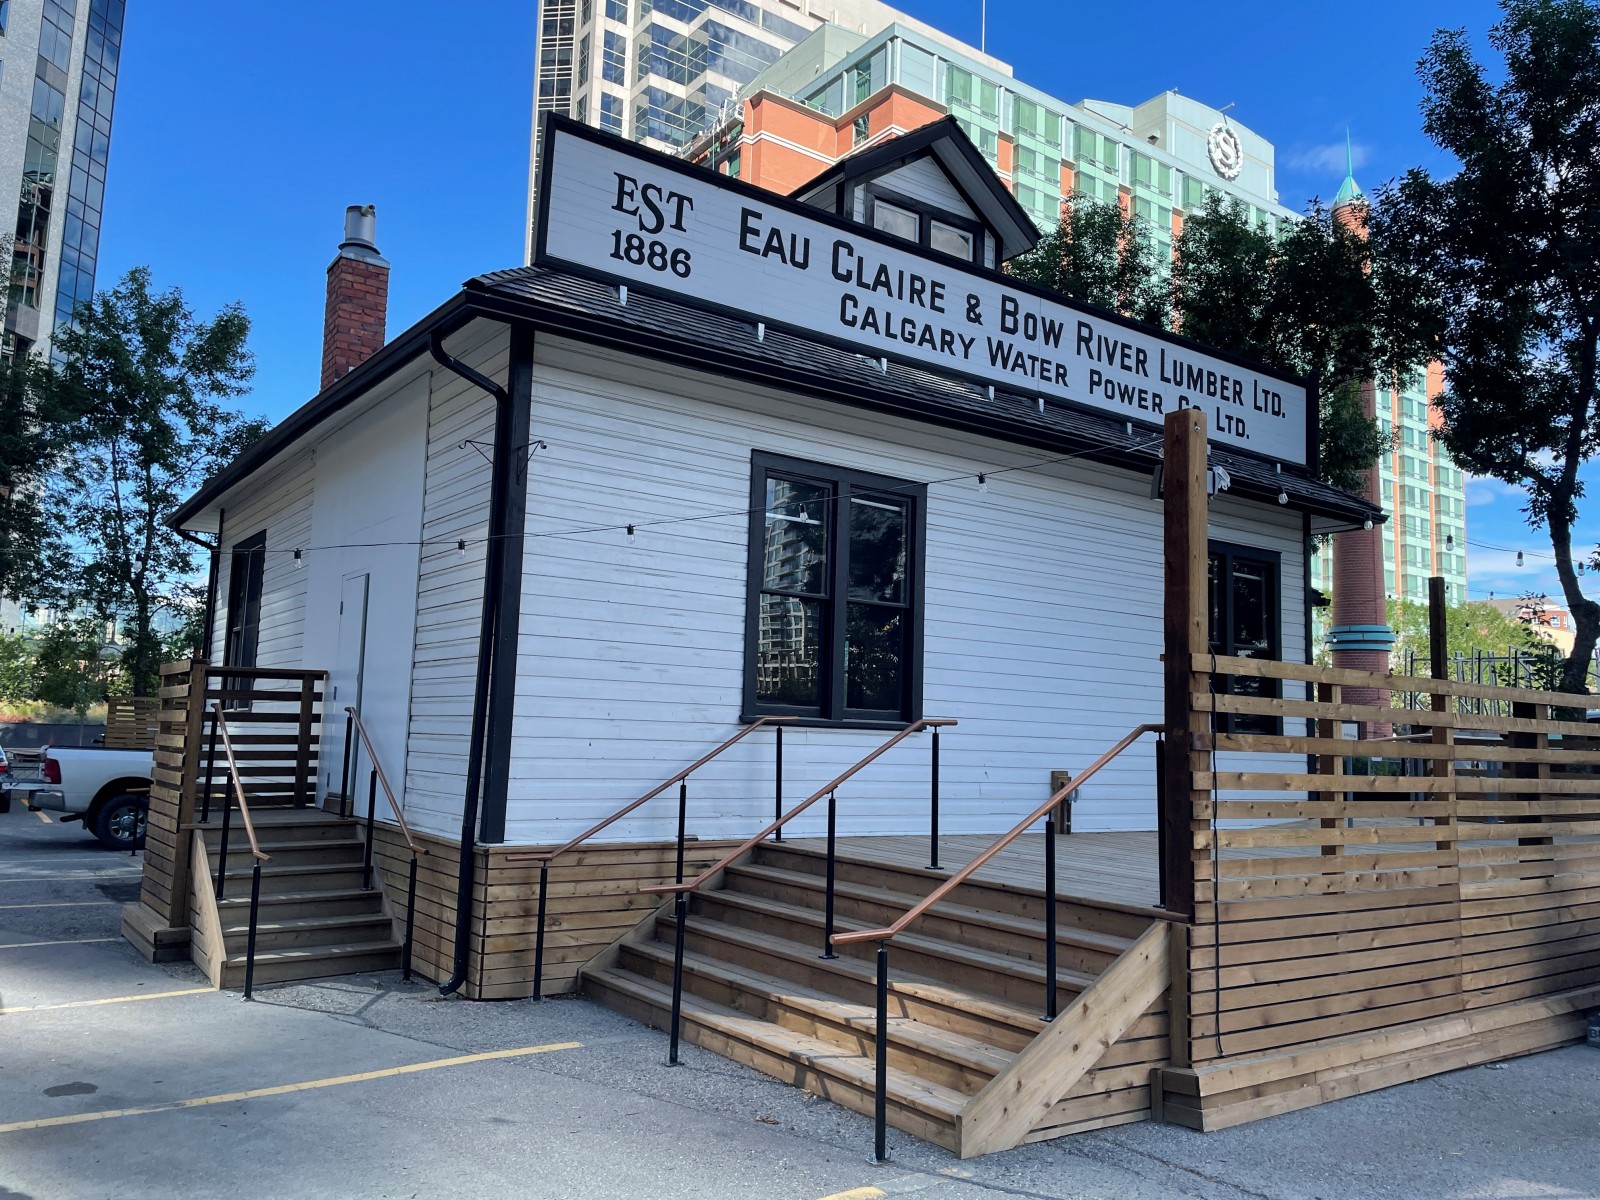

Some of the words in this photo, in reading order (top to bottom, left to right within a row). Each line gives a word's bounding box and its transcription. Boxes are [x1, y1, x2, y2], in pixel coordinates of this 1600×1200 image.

[610, 229, 692, 278] 1886
[611, 172, 694, 235] EST
[739, 206, 810, 270] EAU
[831, 239, 945, 314] CLAIRE
[966, 293, 984, 326] &
[1000, 294, 1064, 349] BOW
[1077, 320, 1149, 378] RIVER
[1160, 347, 1244, 407] LUMBER
[1253, 378, 1285, 418] LTD.
[840, 292, 976, 360] CALGARY
[987, 336, 1069, 387] WATER
[1090, 369, 1163, 415] POWER
[1216, 406, 1250, 439] LTD.
